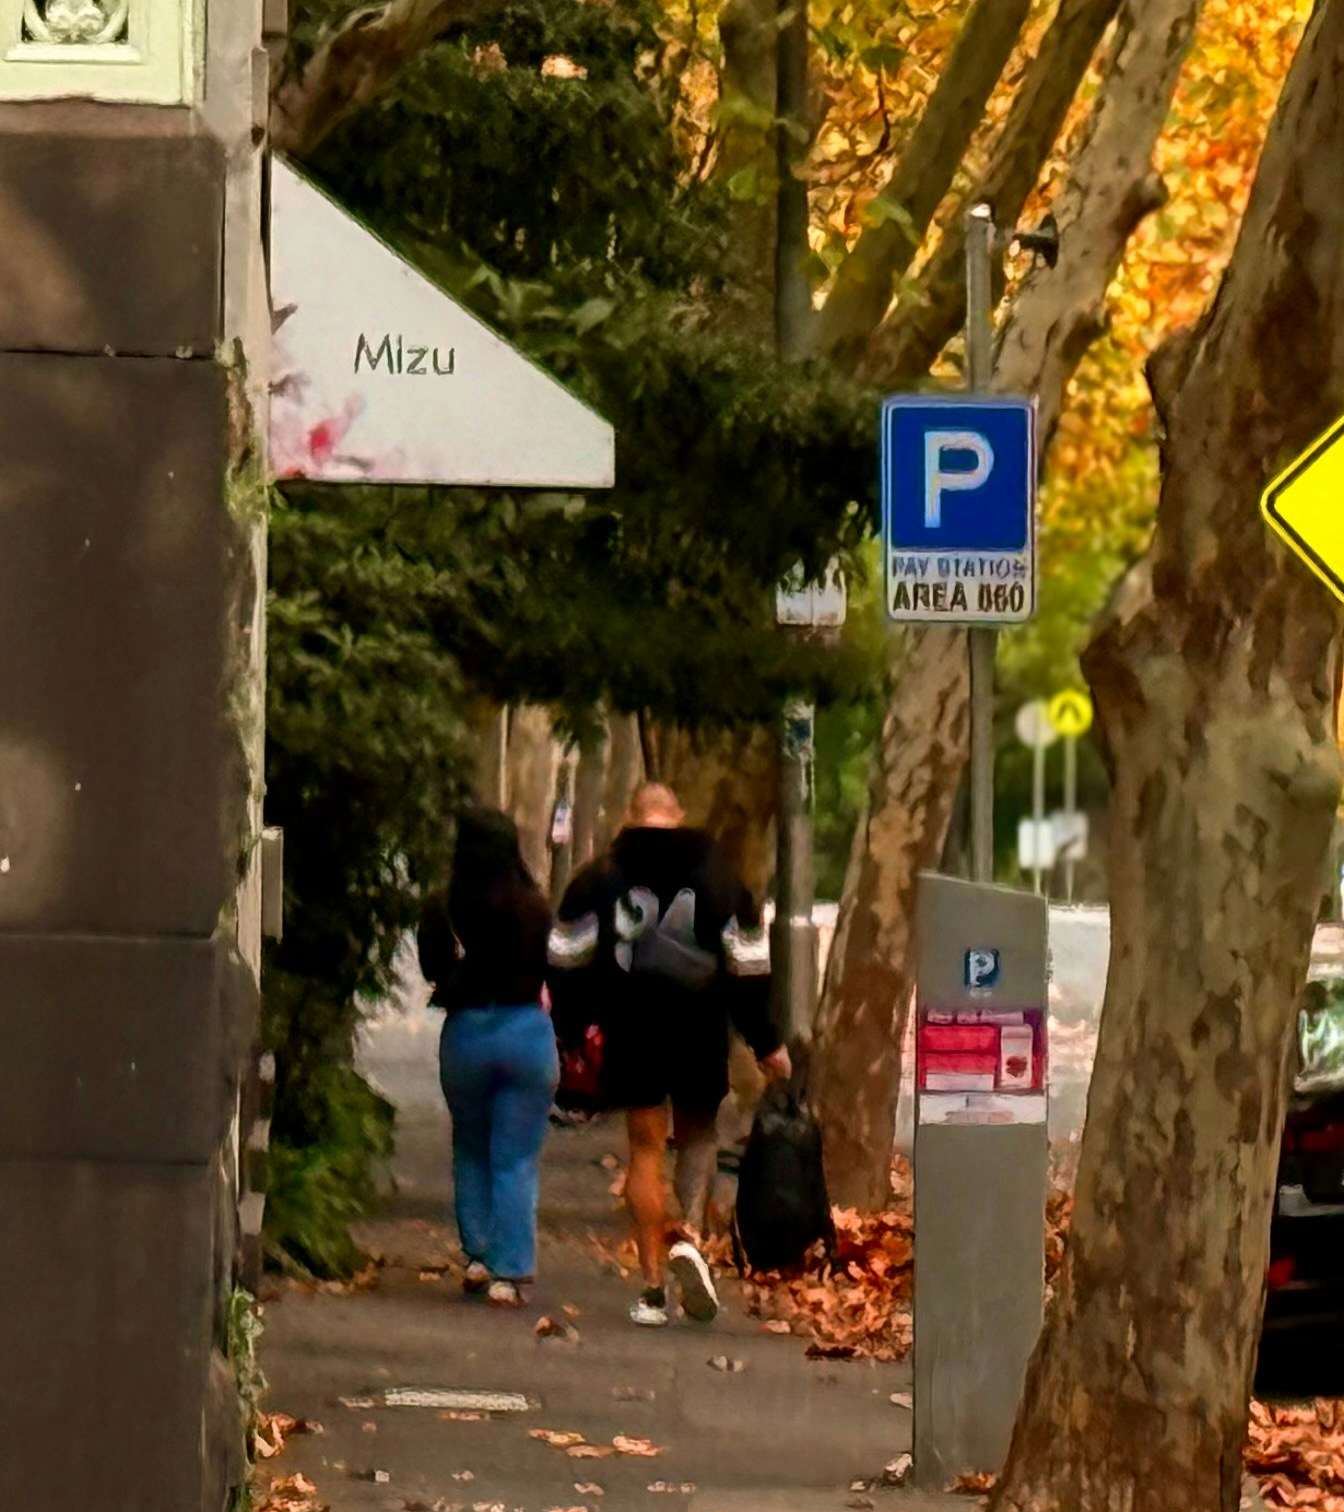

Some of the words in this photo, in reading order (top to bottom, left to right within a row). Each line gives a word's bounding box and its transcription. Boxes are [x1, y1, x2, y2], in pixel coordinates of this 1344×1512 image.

[924, 431, 994, 528] P
[893, 580, 968, 612] AREA
[969, 950, 995, 986] P
